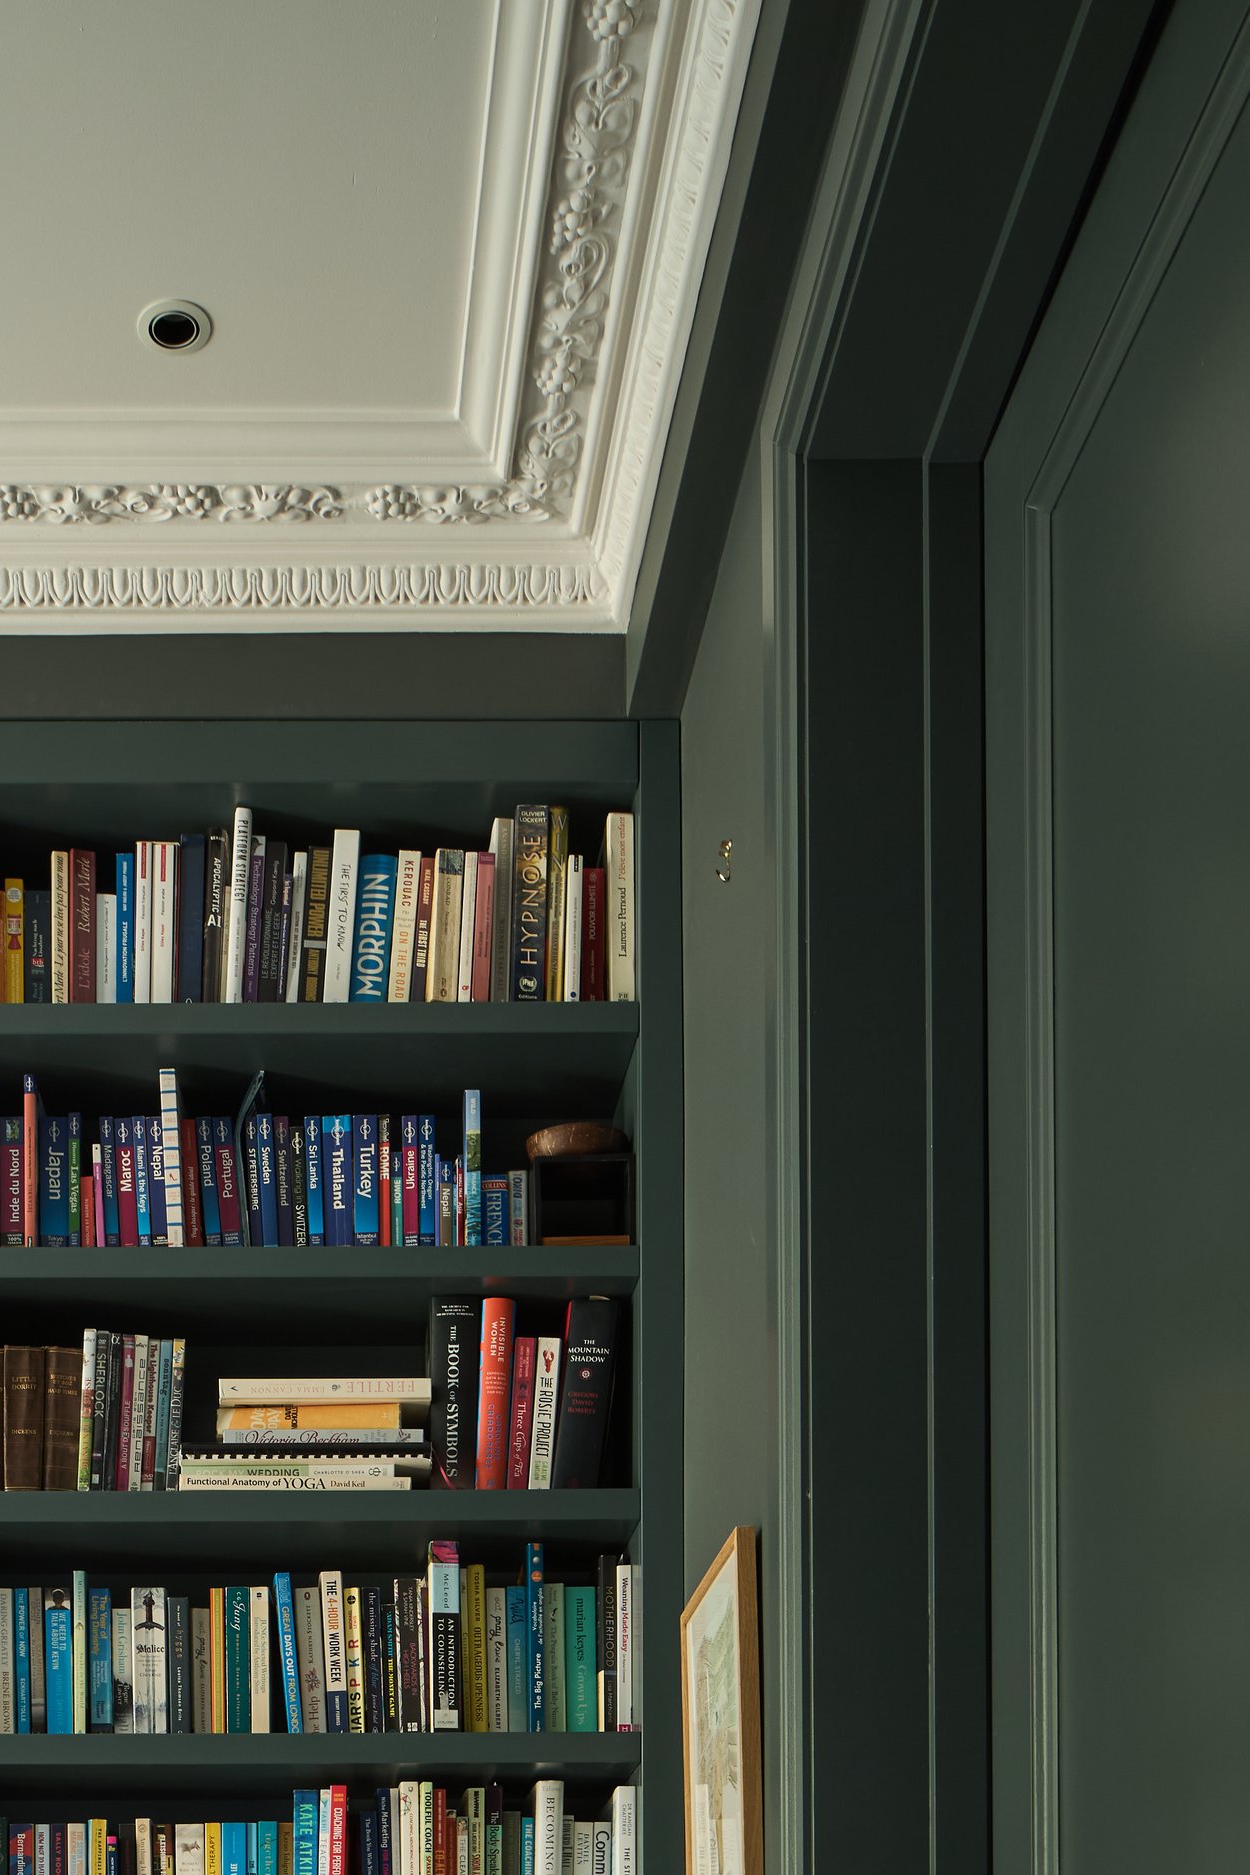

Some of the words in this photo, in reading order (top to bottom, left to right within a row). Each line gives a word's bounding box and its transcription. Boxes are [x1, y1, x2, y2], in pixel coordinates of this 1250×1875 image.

[236, 820, 248, 861] PLATFORM
[212, 858, 221, 913] APOCALYPTIC
[234, 864, 247, 903] STRATEGY
[250, 860, 261, 905] Technology
[311, 850, 329, 899] UNLIMITED
[341, 864, 351, 879] THE
[402, 860, 414, 907] KEROUAC
[338, 882, 350, 905] FIRST
[520, 836, 541, 965] HYPNOSE
[618, 887, 626, 919] Pernoud
[207, 914, 221, 928] AI
[249, 907, 259, 941] Strategy
[307, 902, 326, 937] POWER
[338, 908, 348, 922] TO
[337, 925, 346, 951] KNOW
[356, 874, 390, 996] MORPHIN
[399, 931, 409, 944] ON
[248, 943, 257, 976] Patterns
[397, 950, 407, 967] THE
[395, 972, 406, 999] ROAD
[151, 1146, 165, 1180] Nepal
[201, 1145, 213, 1187] Poland
[261, 1147, 271, 1184] Sweden
[309, 1145, 317, 1158] Sri
[380, 1146, 389, 1180] ROME
[45, 1146, 64, 1199] Japan
[120, 1151, 132, 1191] Maroc
[219, 1150, 233, 1198] Portugal
[279, 1150, 289, 1206] Switzerland
[310, 1161, 318, 1189] Lanka
[332, 1148, 345, 1209] Thailand
[357, 1143, 375, 1198] Turkey
[405, 1151, 415, 1189] Ukraine
[69, 1185, 79, 1213] Vegas
[441, 1188, 450, 1217] Nepali
[490, 1321, 498, 1356] WOMEN
[497, 1317, 506, 1363] INVISIBLE
[568, 1347, 610, 1355] MOUNTAIN
[447, 1343, 459, 1389] BOOK
[570, 1355, 605, 1363] SHADOW
[94, 1353, 106, 1418] SHERLOCK
[449, 1390, 456, 1402] OF
[516, 1402, 526, 1429] Three
[446, 1403, 459, 1477] SYMBOLS
[512, 1431, 526, 1452] Cups
[187, 1477, 230, 1488] Functional
[232, 1477, 271, 1488] Anatomy
[272, 1477, 282, 1486] of
[282, 1477, 326, 1489] YOGA
[330, 1480, 351, 1488] David
[352, 1480, 365, 1488] Keil
[514, 1461, 523, 1477] Tea
[326, 1580, 337, 1596] THE
[621, 1577, 629, 1612] Weaning
[0, 1593, 8, 1627] DARING
[327, 1598, 339, 1630] 4-HOUR
[438, 1618, 445, 1630] TO
[447, 1618, 455, 1631] AN
[606, 1586, 614, 1667] MOTHERHOOD
[1, 1628, 9, 1666] GREATLY
[329, 1632, 340, 1657] WORK
[621, 1634, 629, 1652] Easy
[2, 1671, 10, 1699] BRENÉ
[330, 1659, 341, 1683] WEEK
[447, 1634, 455, 1707] INTRODUCTION
[3, 1700, 11, 1732] BROWN
[299, 1804, 312, 1835] KATE
[490, 1811, 499, 1825] The
[545, 1797, 555, 1871] BECOMING
[489, 1826, 500, 1848] Body
[17, 1833, 25, 1875] Bernardine
